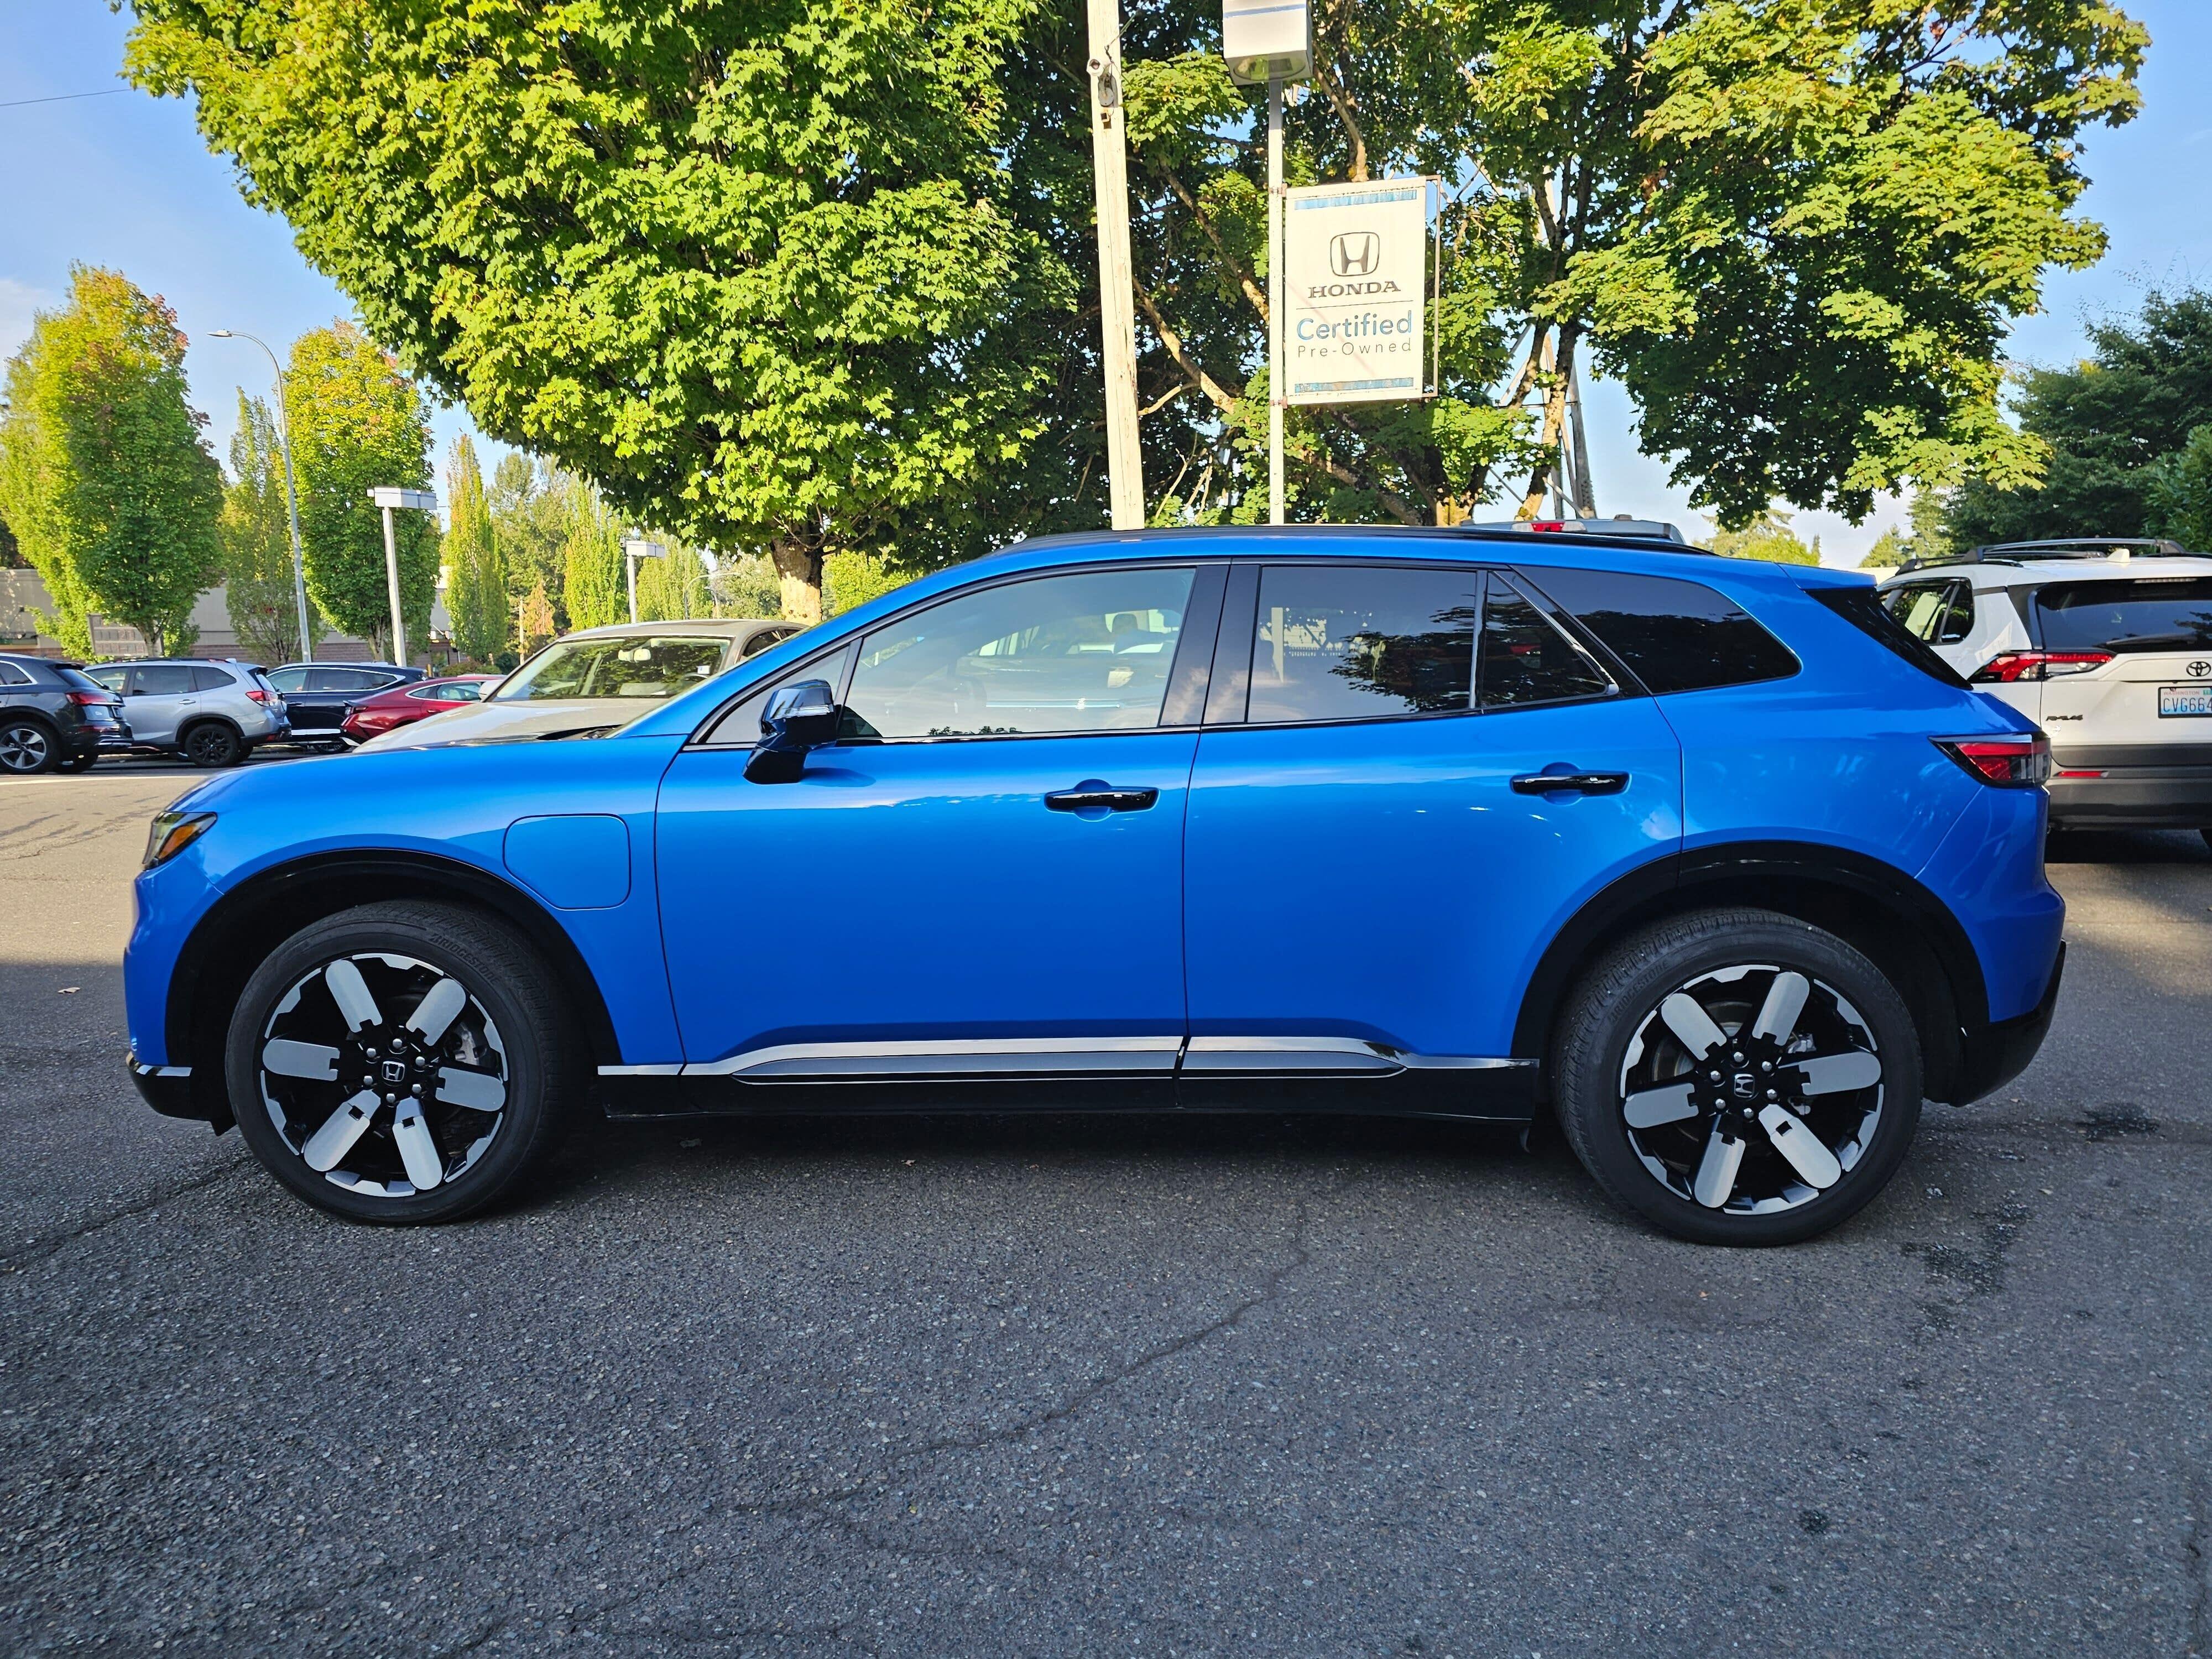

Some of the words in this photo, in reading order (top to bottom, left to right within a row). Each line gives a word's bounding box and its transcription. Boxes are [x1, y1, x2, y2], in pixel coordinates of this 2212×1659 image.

[1307, 280, 1401, 299] HONDA
[1296, 310, 1412, 340] Certified
[1297, 337, 1412, 358] Pre-Owned
[428, 932, 501, 985] BRIDGESTONE
